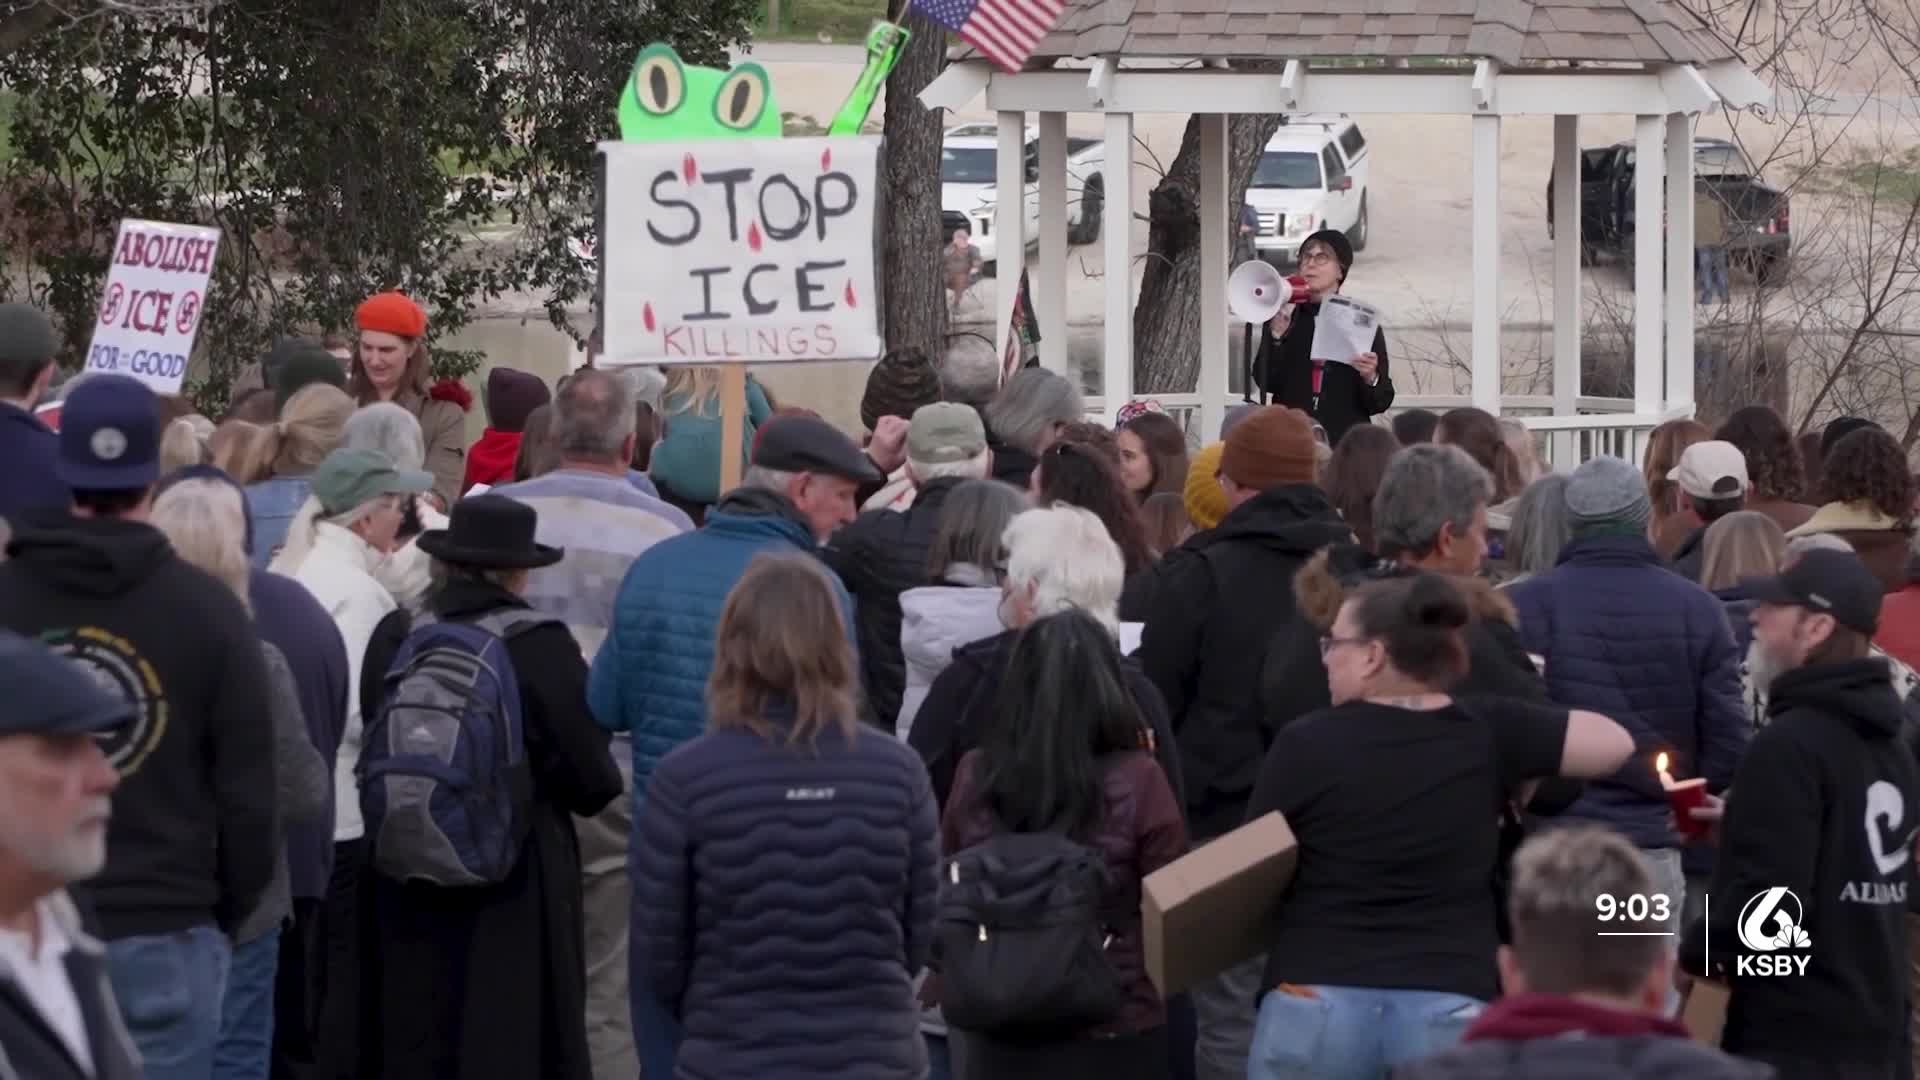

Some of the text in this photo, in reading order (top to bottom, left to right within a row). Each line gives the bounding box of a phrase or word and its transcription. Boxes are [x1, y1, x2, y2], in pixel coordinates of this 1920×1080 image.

[647, 168, 858, 246] STOP
[115, 232, 216, 274] ABOLISH
[121, 288, 174, 336] ICE
[682, 259, 846, 321] ICE
[88, 344, 186, 378] FOR GOOD
[662, 324, 838, 357] KILLINGS
